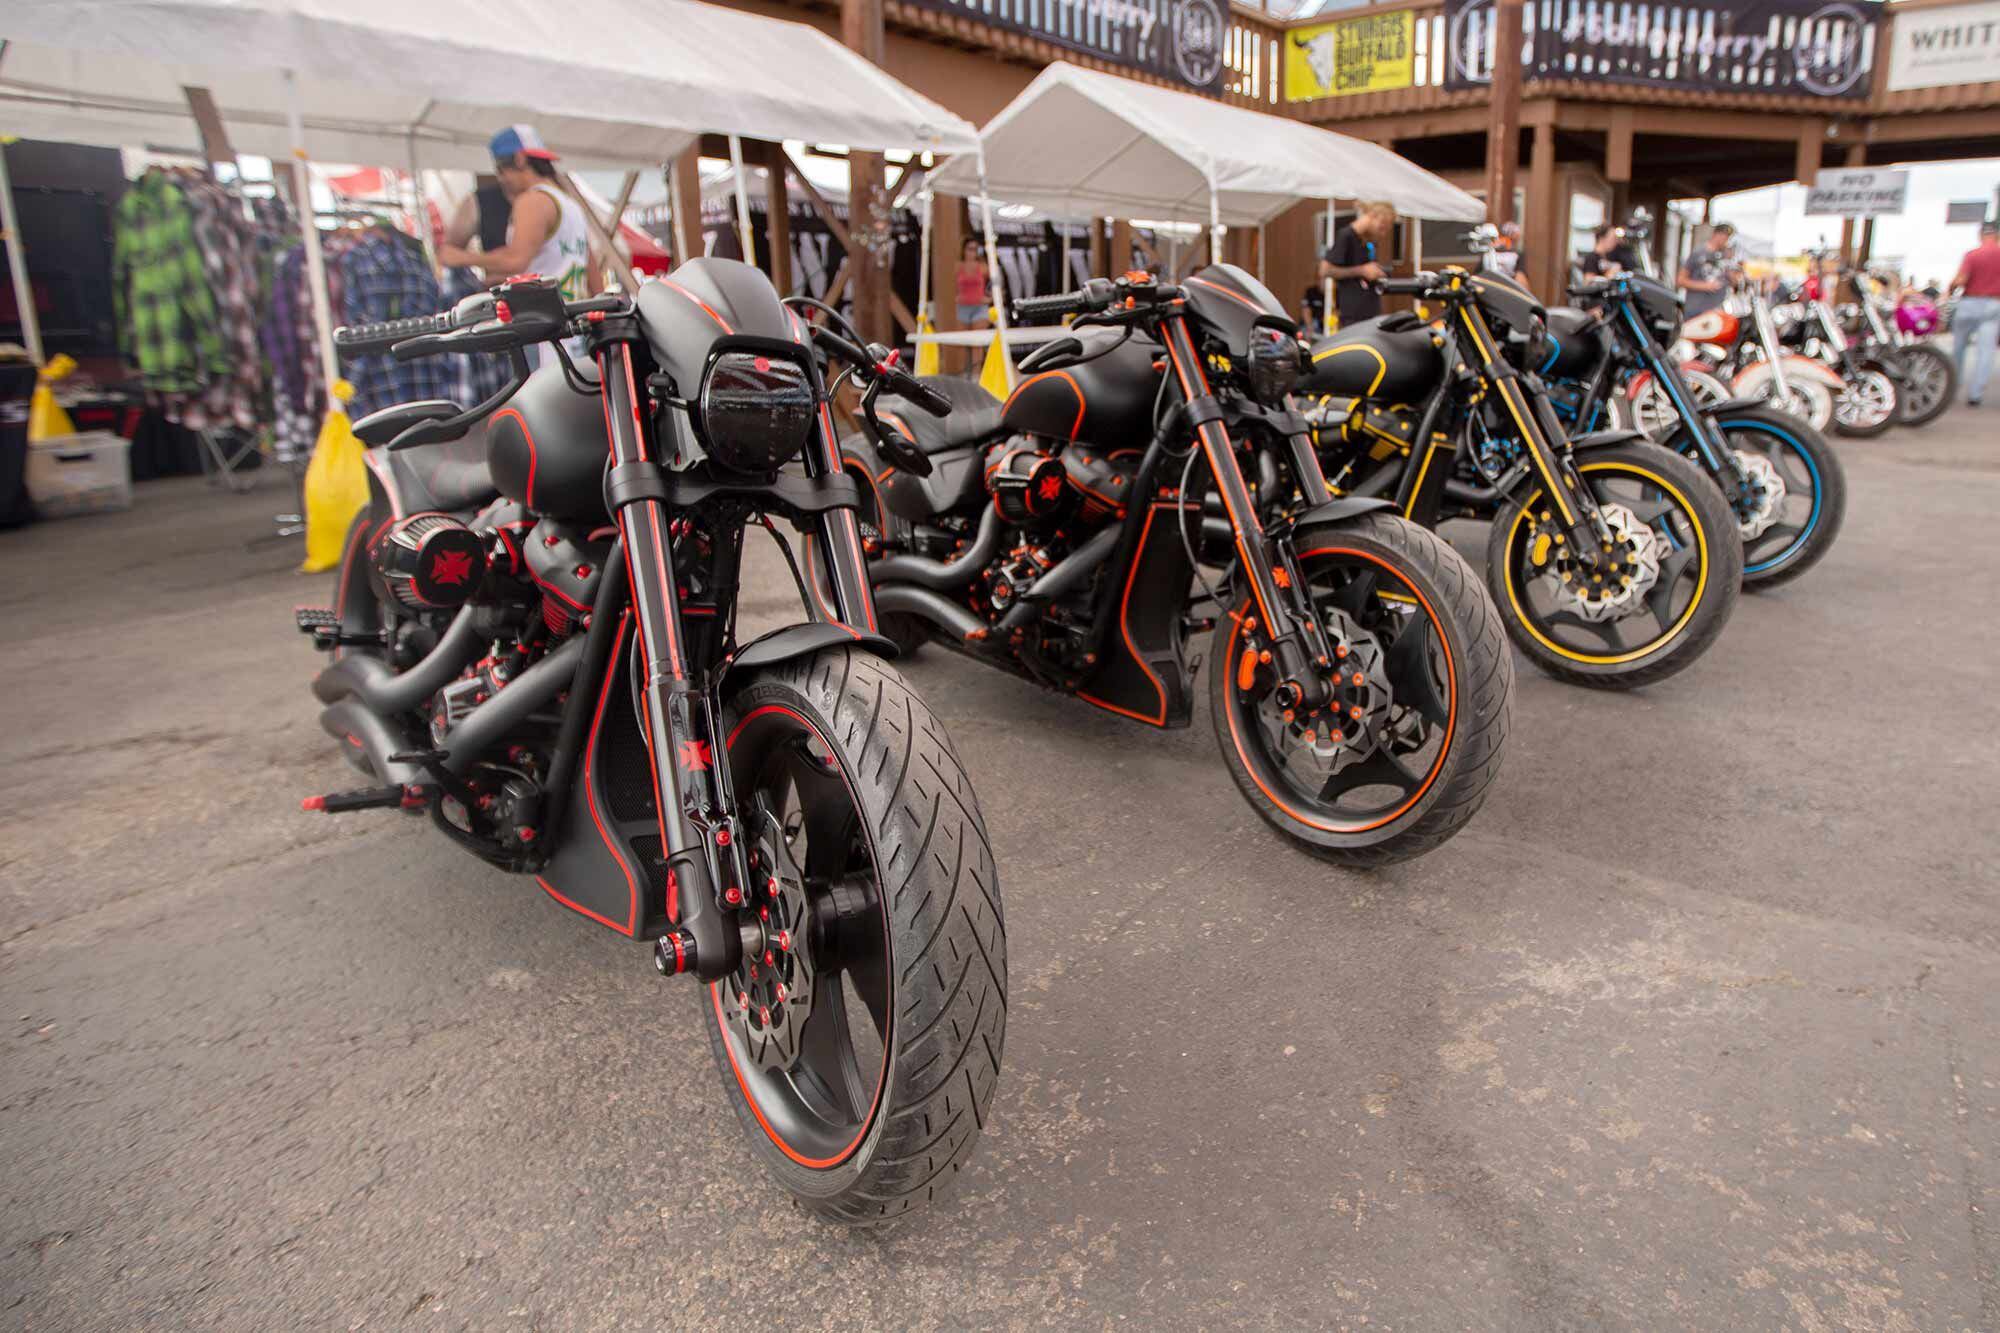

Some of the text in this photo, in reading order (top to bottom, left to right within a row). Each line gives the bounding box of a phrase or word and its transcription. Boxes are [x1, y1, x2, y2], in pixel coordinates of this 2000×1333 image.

[1336, 38, 1405, 67] BUFFALO
[1840, 174, 1875, 187] NO
[1811, 189, 1900, 204] PARKING
